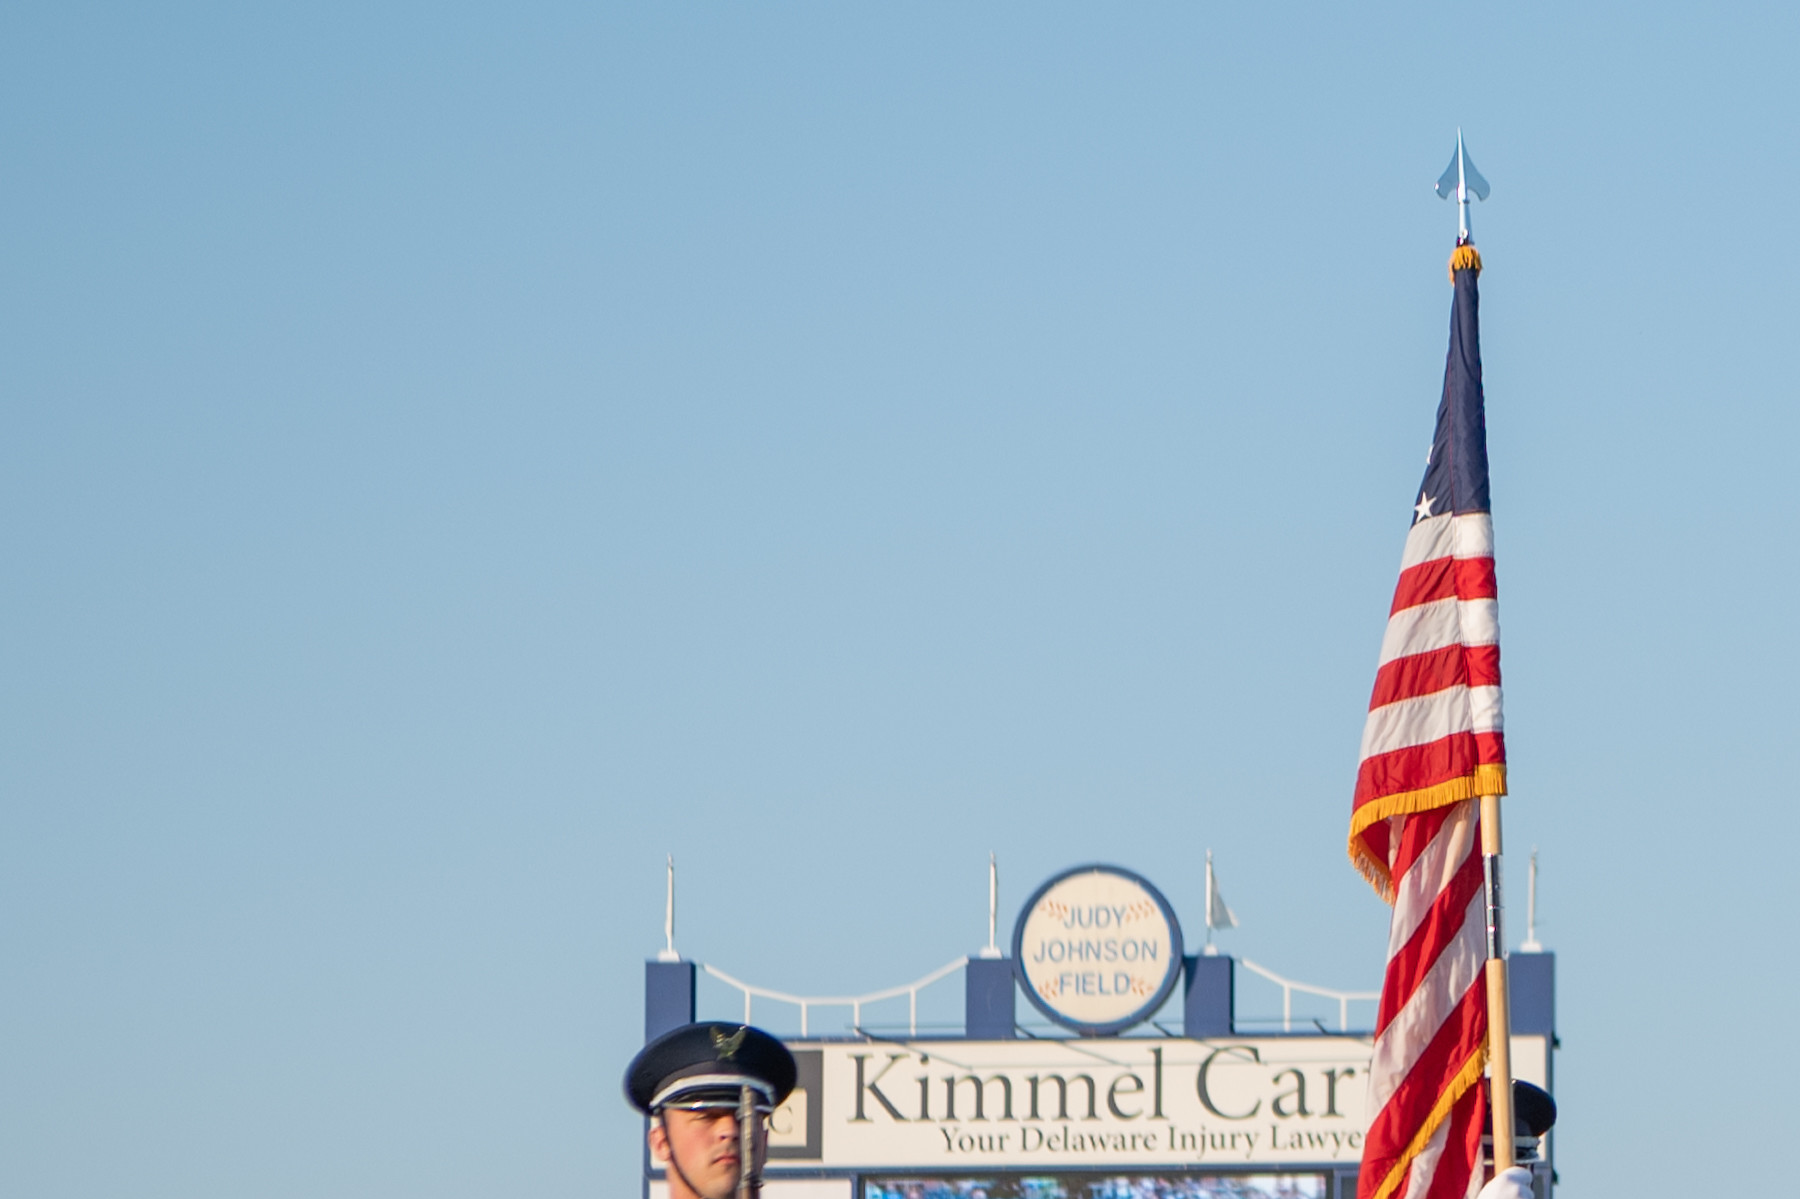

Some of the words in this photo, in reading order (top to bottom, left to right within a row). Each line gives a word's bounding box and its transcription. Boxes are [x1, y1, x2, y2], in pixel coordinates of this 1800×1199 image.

[1063, 904, 1127, 930] JUDY
[1033, 939, 1158, 963] JOHNSON
[1059, 971, 1131, 996] FIELD
[847, 1047, 1169, 1122] Kimmel
[1196, 1045, 1369, 1121] Car
[940, 1126, 1010, 1153] Your
[1019, 1125, 1158, 1152] Delaware
[1169, 1125, 1261, 1160] Injury
[1271, 1125, 1363, 1159] Lawye
